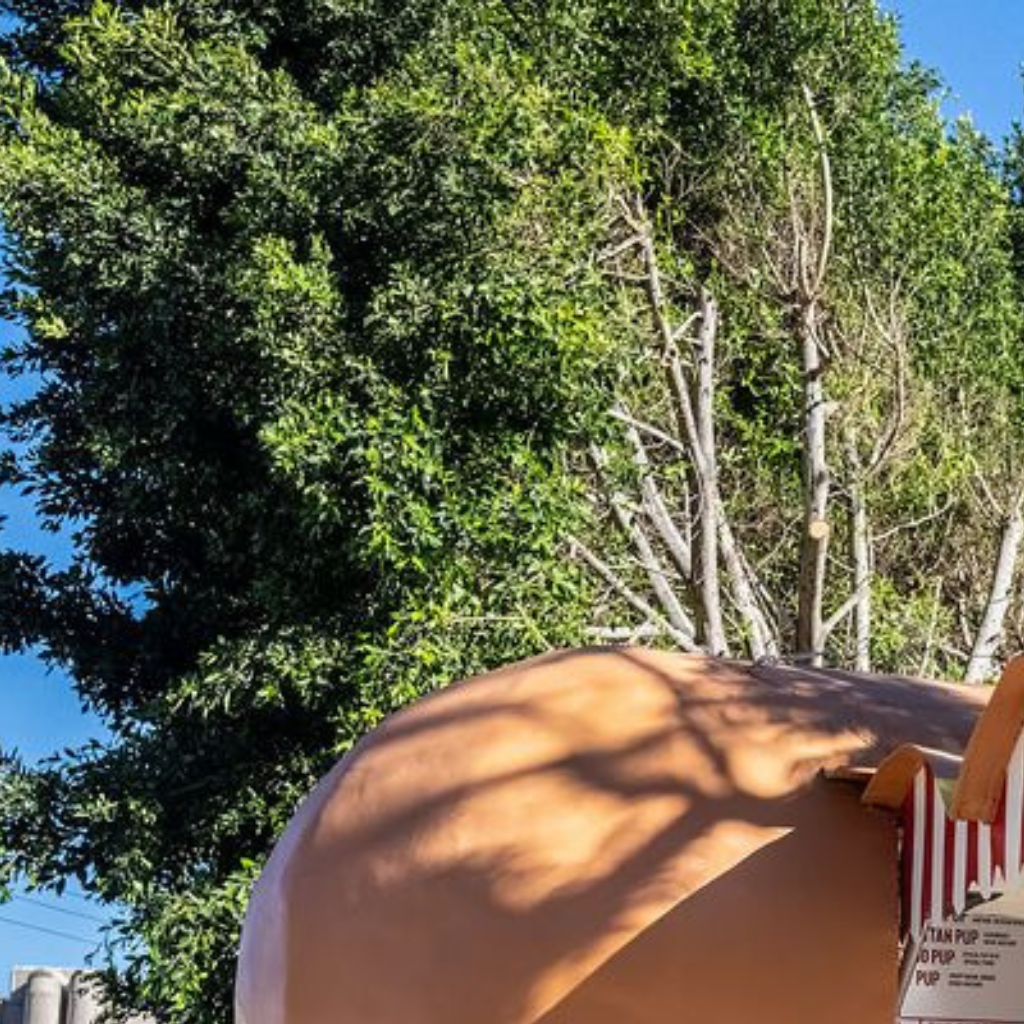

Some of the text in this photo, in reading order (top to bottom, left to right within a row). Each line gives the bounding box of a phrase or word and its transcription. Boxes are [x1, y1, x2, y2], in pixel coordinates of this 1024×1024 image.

[955, 928, 979, 946] PUP
[931, 949, 955, 966] PUP
[916, 970, 940, 987] PUP
